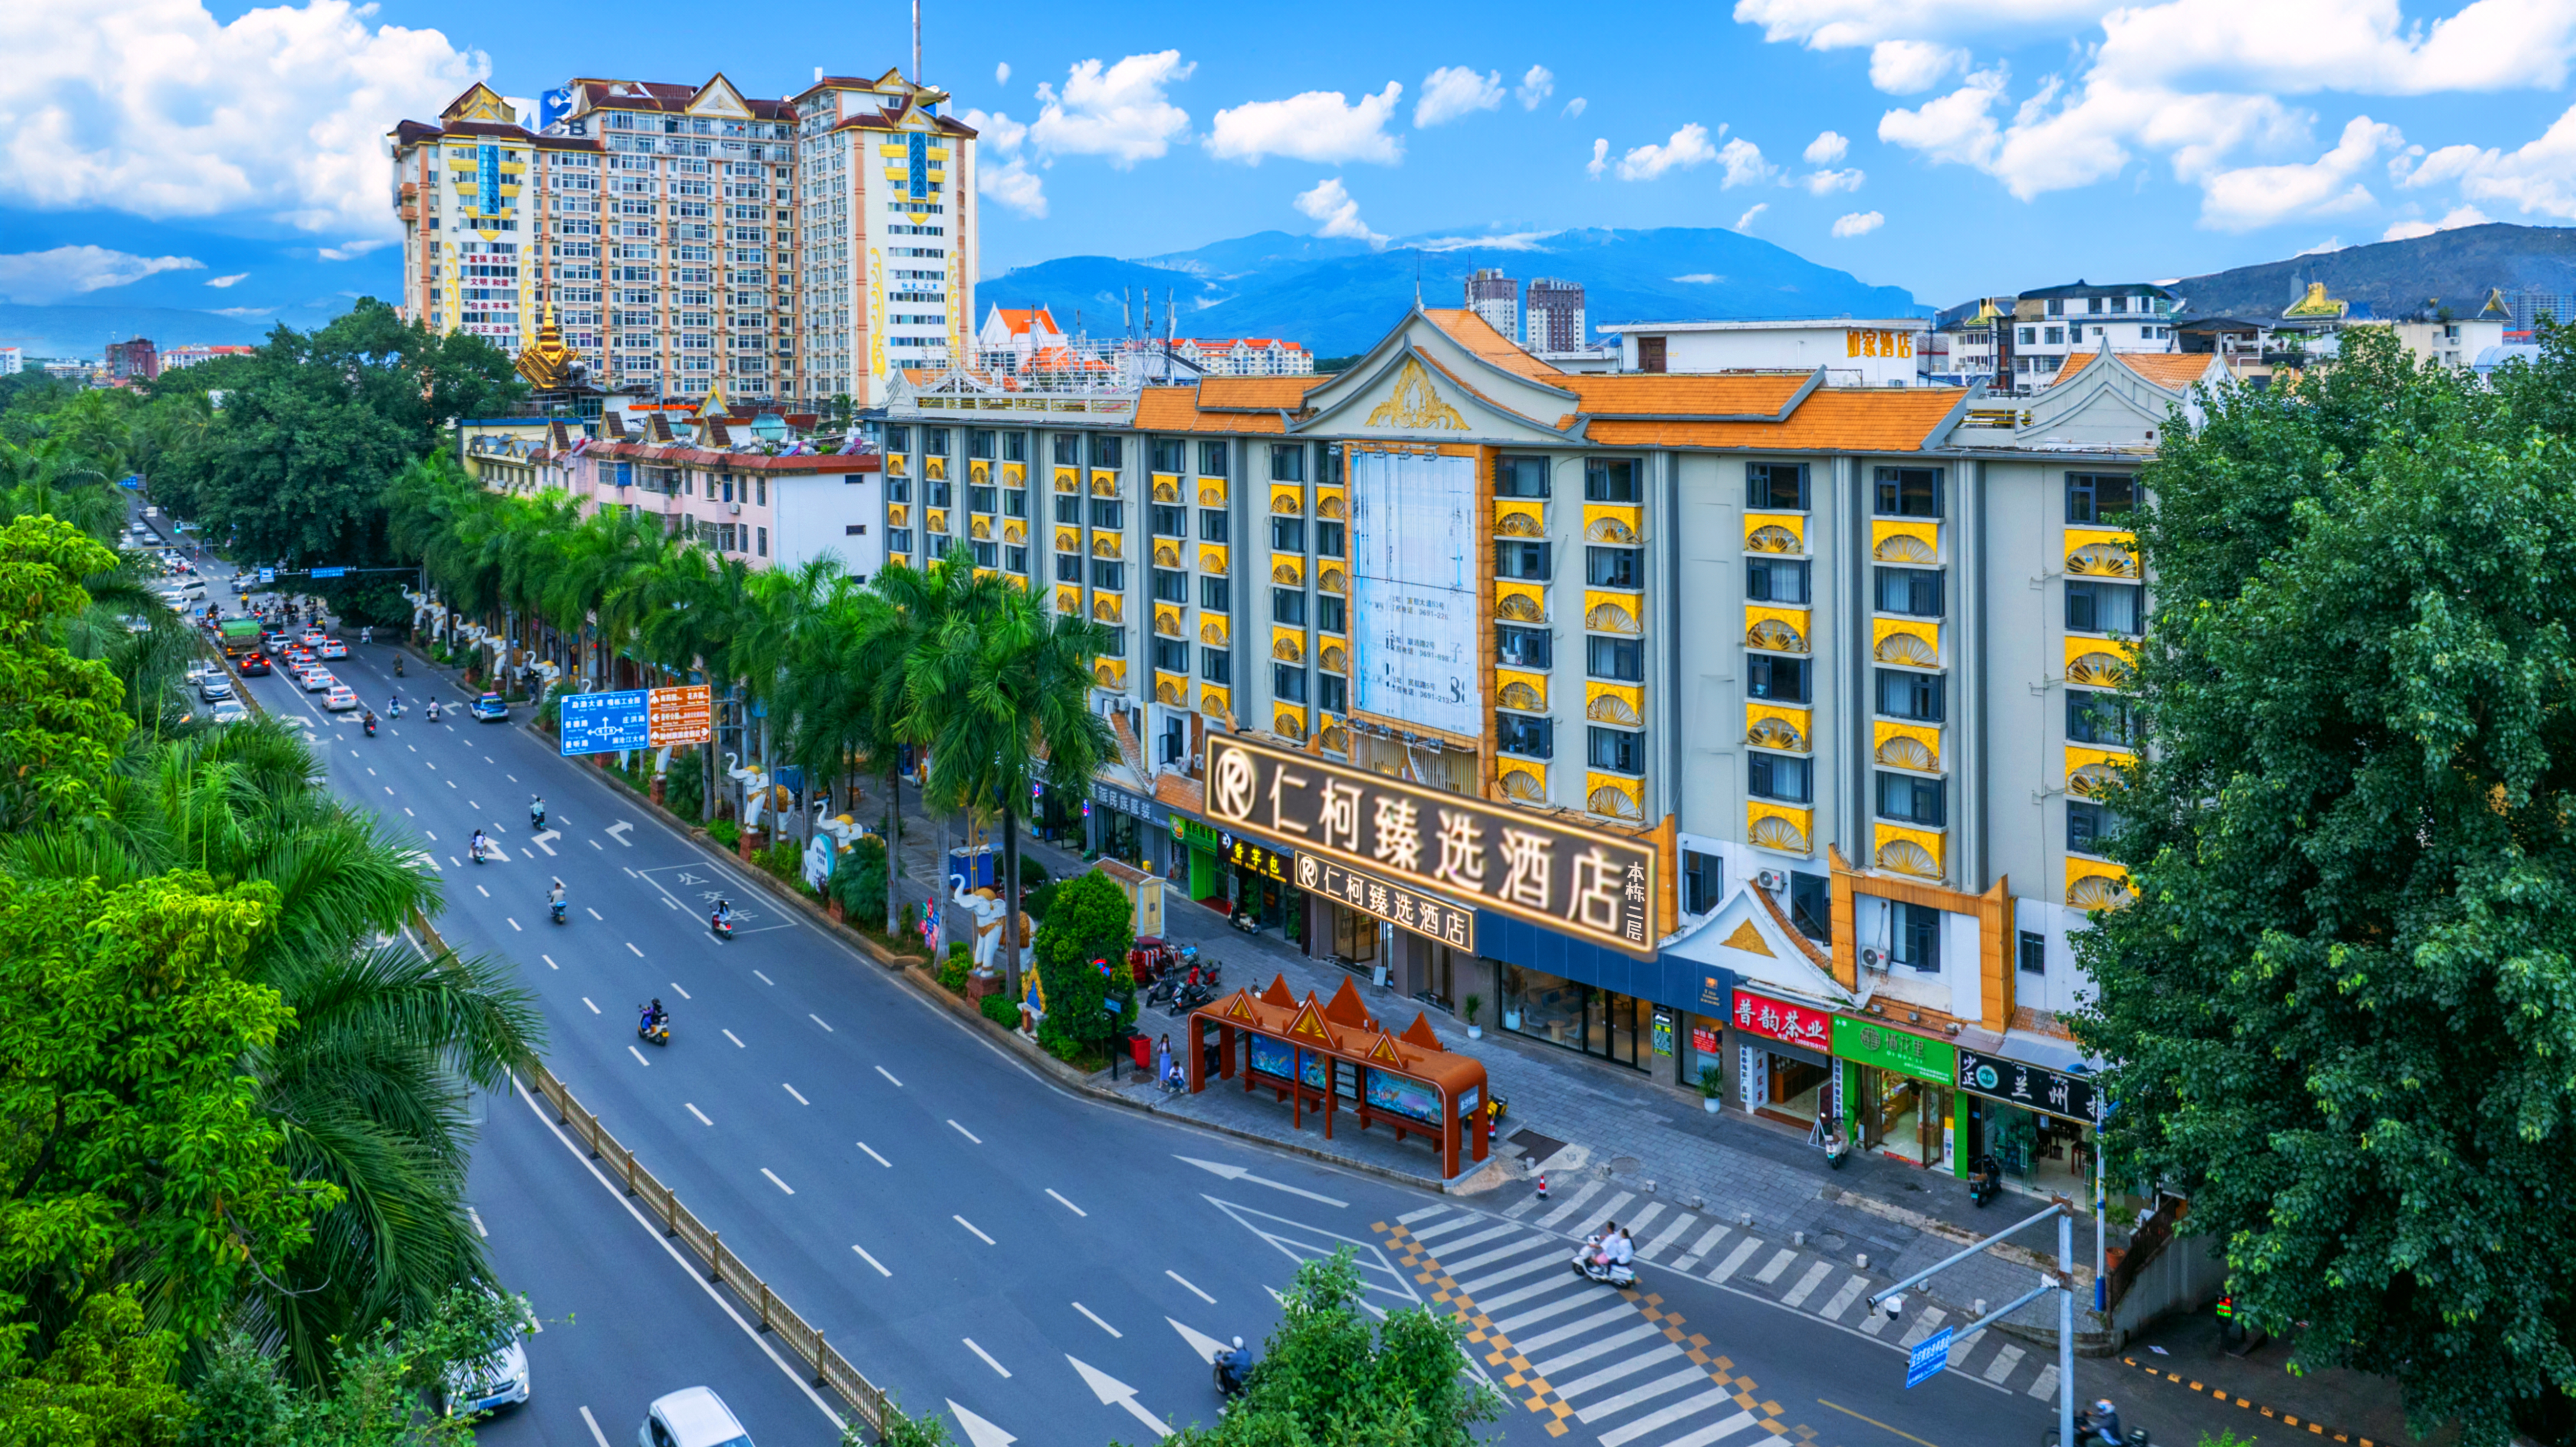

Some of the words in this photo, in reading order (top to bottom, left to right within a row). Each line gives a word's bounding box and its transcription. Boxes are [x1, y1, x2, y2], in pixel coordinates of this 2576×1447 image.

[1847, 329, 1911, 358] 如家酒店
[1269, 764, 1625, 933] 仁柯臻选酒店
[1625, 861, 1645, 941] 本栋二层
[1324, 866, 1465, 946] 仁柯臻选酒店
[1735, 998, 1826, 1040] 普韵茶业
[1886, 1031, 1925, 1058] 栖花里
